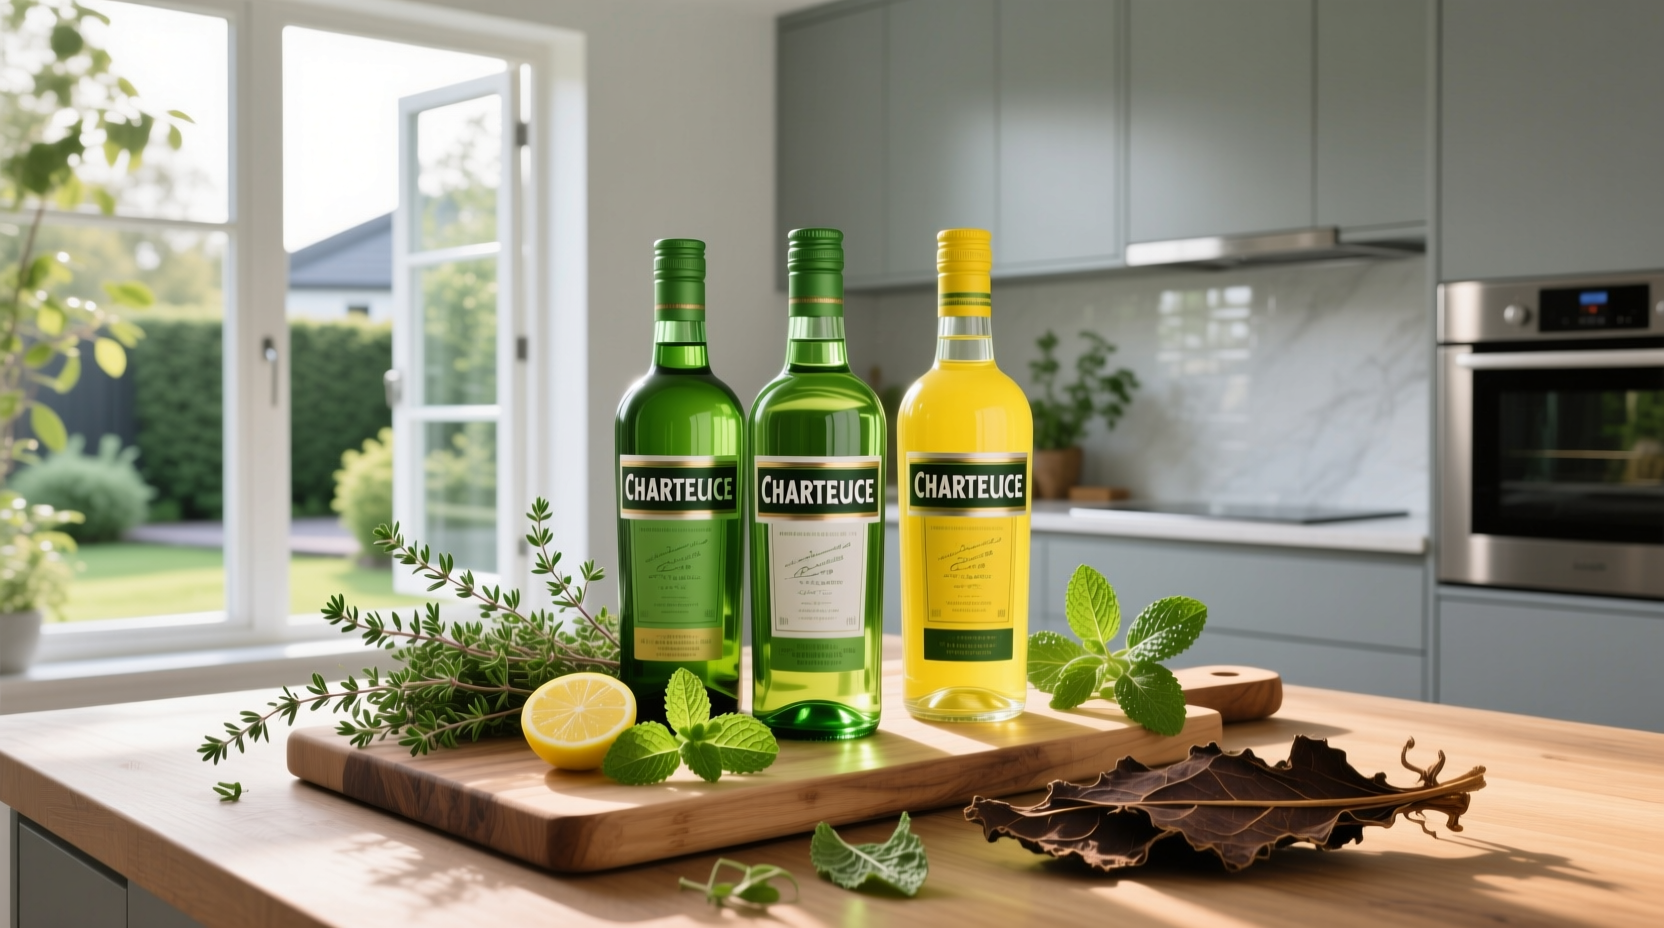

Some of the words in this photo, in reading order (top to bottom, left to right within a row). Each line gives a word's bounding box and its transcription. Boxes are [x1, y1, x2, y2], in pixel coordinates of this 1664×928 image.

[625, 473, 733, 502] CHARTEUCE
[761, 475, 874, 504] CHARTEUCE
[914, 471, 1023, 499] CHARTEUCE
